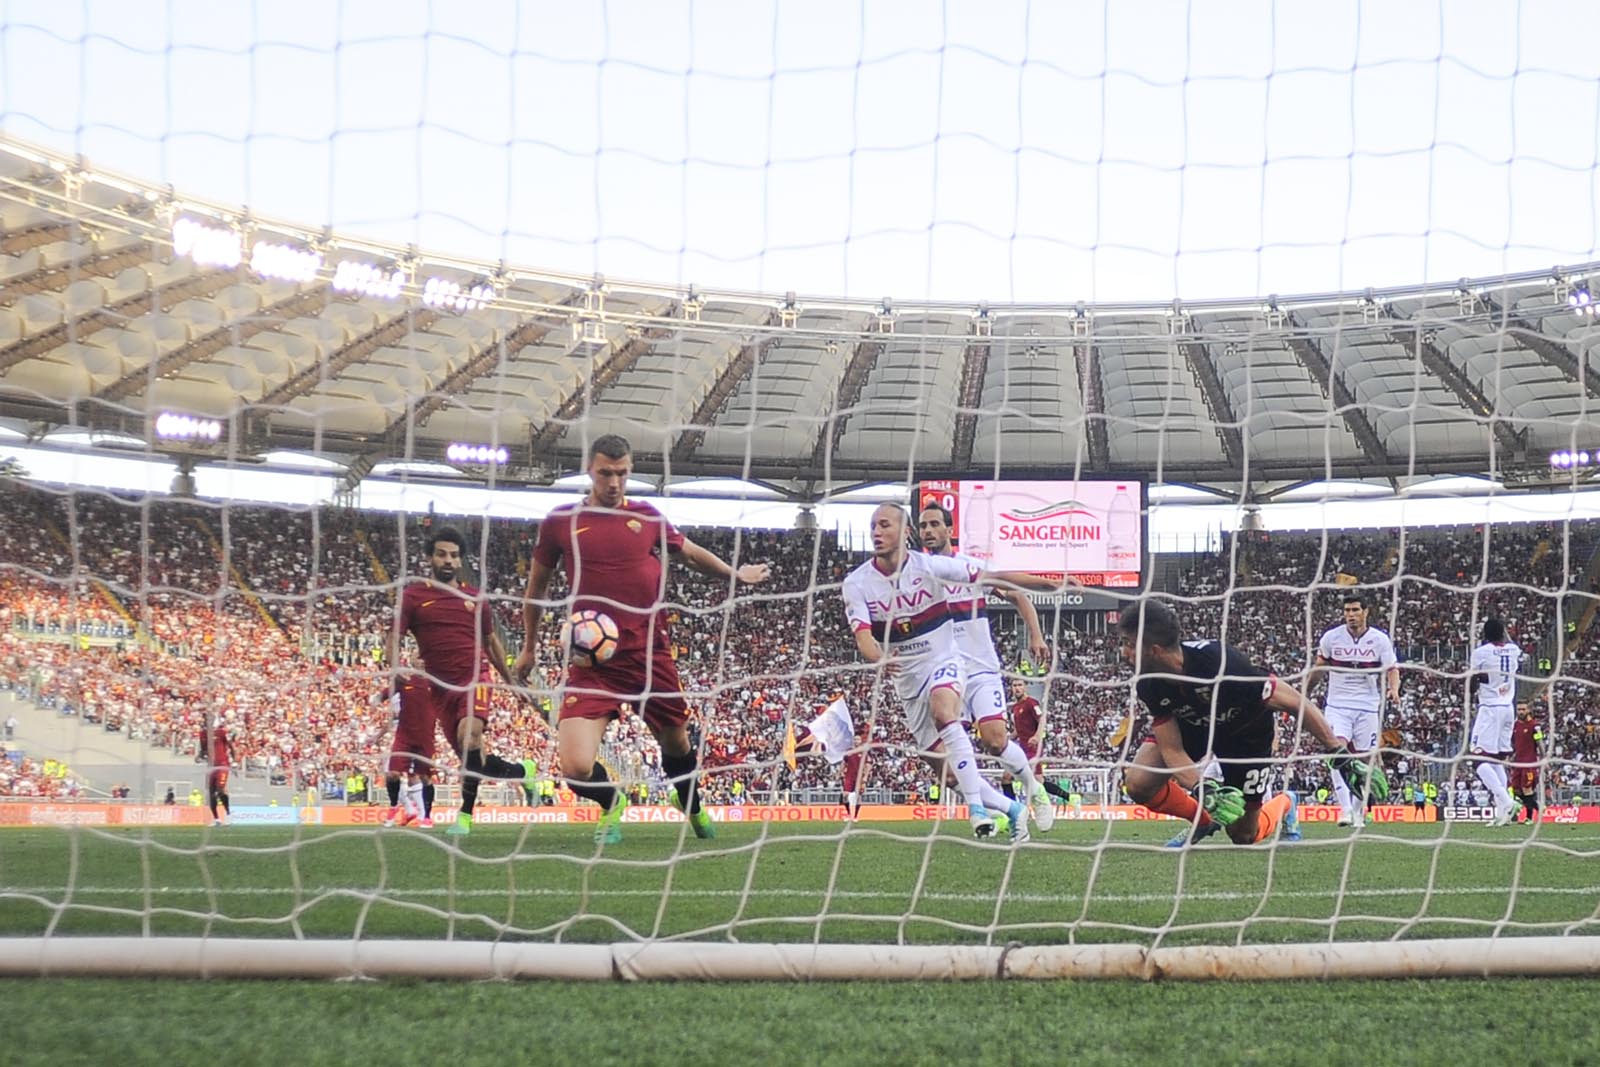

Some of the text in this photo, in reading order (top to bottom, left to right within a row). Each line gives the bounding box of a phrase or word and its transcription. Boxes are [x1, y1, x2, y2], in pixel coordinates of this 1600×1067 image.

[943, 494, 955, 512] 0
[999, 525, 1101, 540] SANGEMINI
[1334, 647, 1376, 657] EVIVA
[994, 690, 1002, 708] 3
[1243, 767, 1270, 794] 23
[748, 808, 801, 821] FOTO
[1304, 807, 1404, 822] FOT IVE
